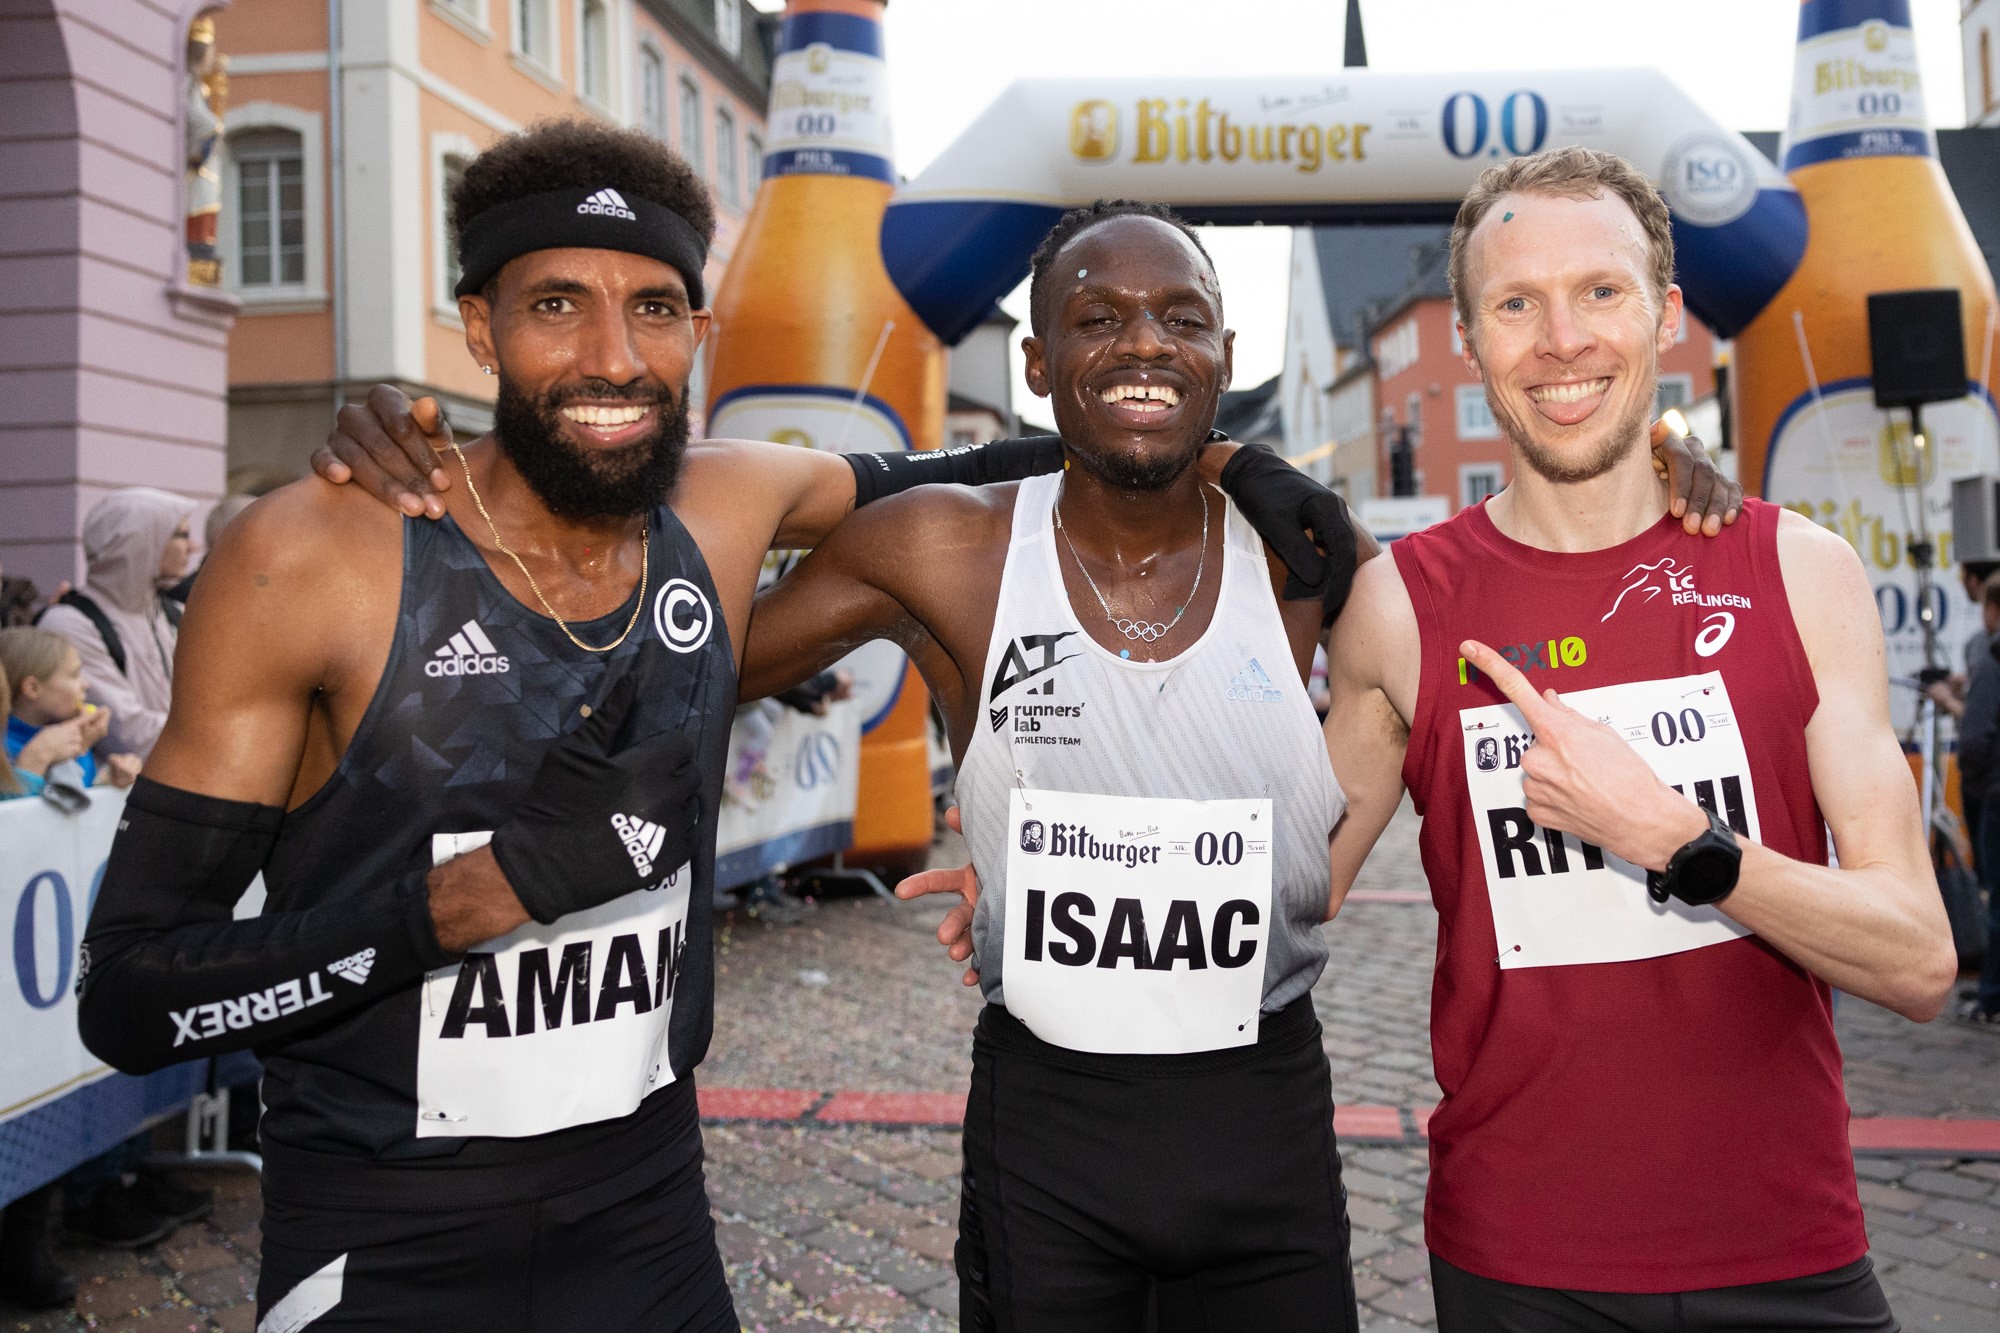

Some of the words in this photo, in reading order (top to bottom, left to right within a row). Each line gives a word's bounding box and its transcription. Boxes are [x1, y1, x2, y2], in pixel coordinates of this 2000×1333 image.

[1132, 98, 1370, 173] Bitburger
[1440, 88, 1549, 159] 0.0
[1686, 157, 1736, 183] ISO
[576, 201, 637, 221] adidas
[1669, 574, 1695, 592] LC
[1671, 590, 1752, 610] REHLINGEN
[424, 654, 511, 678] adidas
[1225, 688, 1283, 703] adidas
[1014, 717, 1041, 732] lab
[1651, 708, 1706, 747] 0.0
[1014, 736, 1057, 745] ATHLETICS
[1058, 736, 1081, 746] TEAM
[610, 812, 654, 878] adidas
[1048, 822, 1161, 869] Bitburger
[1173, 844, 1188, 852] Alk.
[1194, 831, 1244, 866] 0.0
[1024, 888, 1260, 971] ISAAC
[326, 947, 377, 975] adidas
[168, 971, 334, 1048] TERREX
